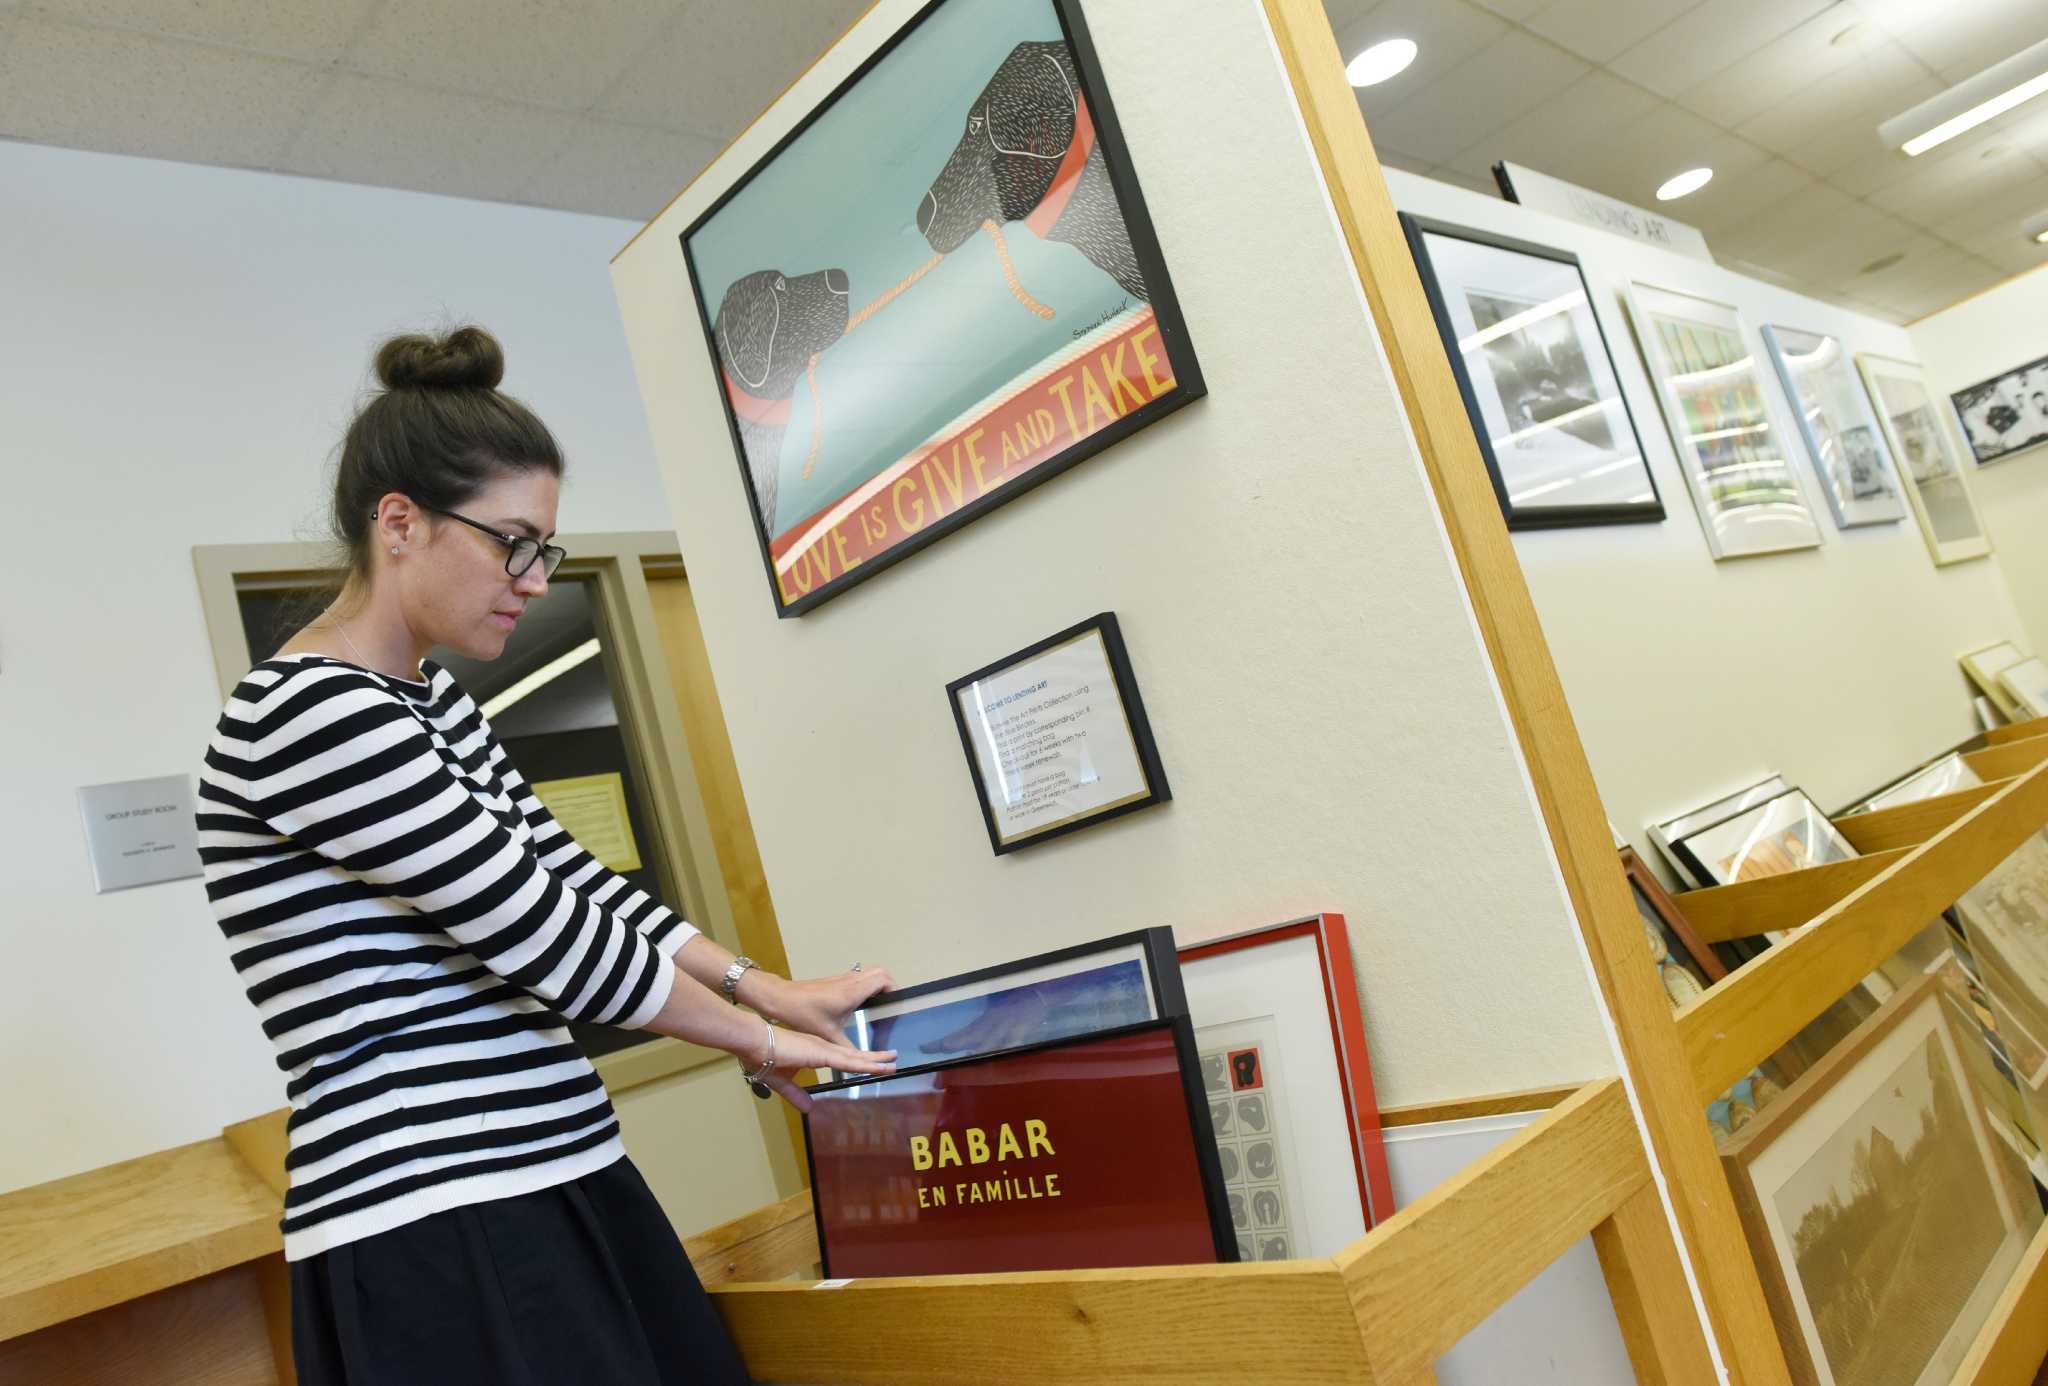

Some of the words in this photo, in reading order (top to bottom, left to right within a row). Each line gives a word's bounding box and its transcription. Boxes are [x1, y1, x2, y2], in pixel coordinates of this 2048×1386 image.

[772, 515, 863, 606] LOVE
[860, 505, 888, 546] IS
[892, 428, 1004, 533] GIVE
[1001, 409, 1055, 468] AND
[1049, 324, 1177, 442] TAKE
[1036, 681, 1048, 689] ART
[910, 1118, 1056, 1171] BABAR
[917, 1186, 946, 1209] EN
